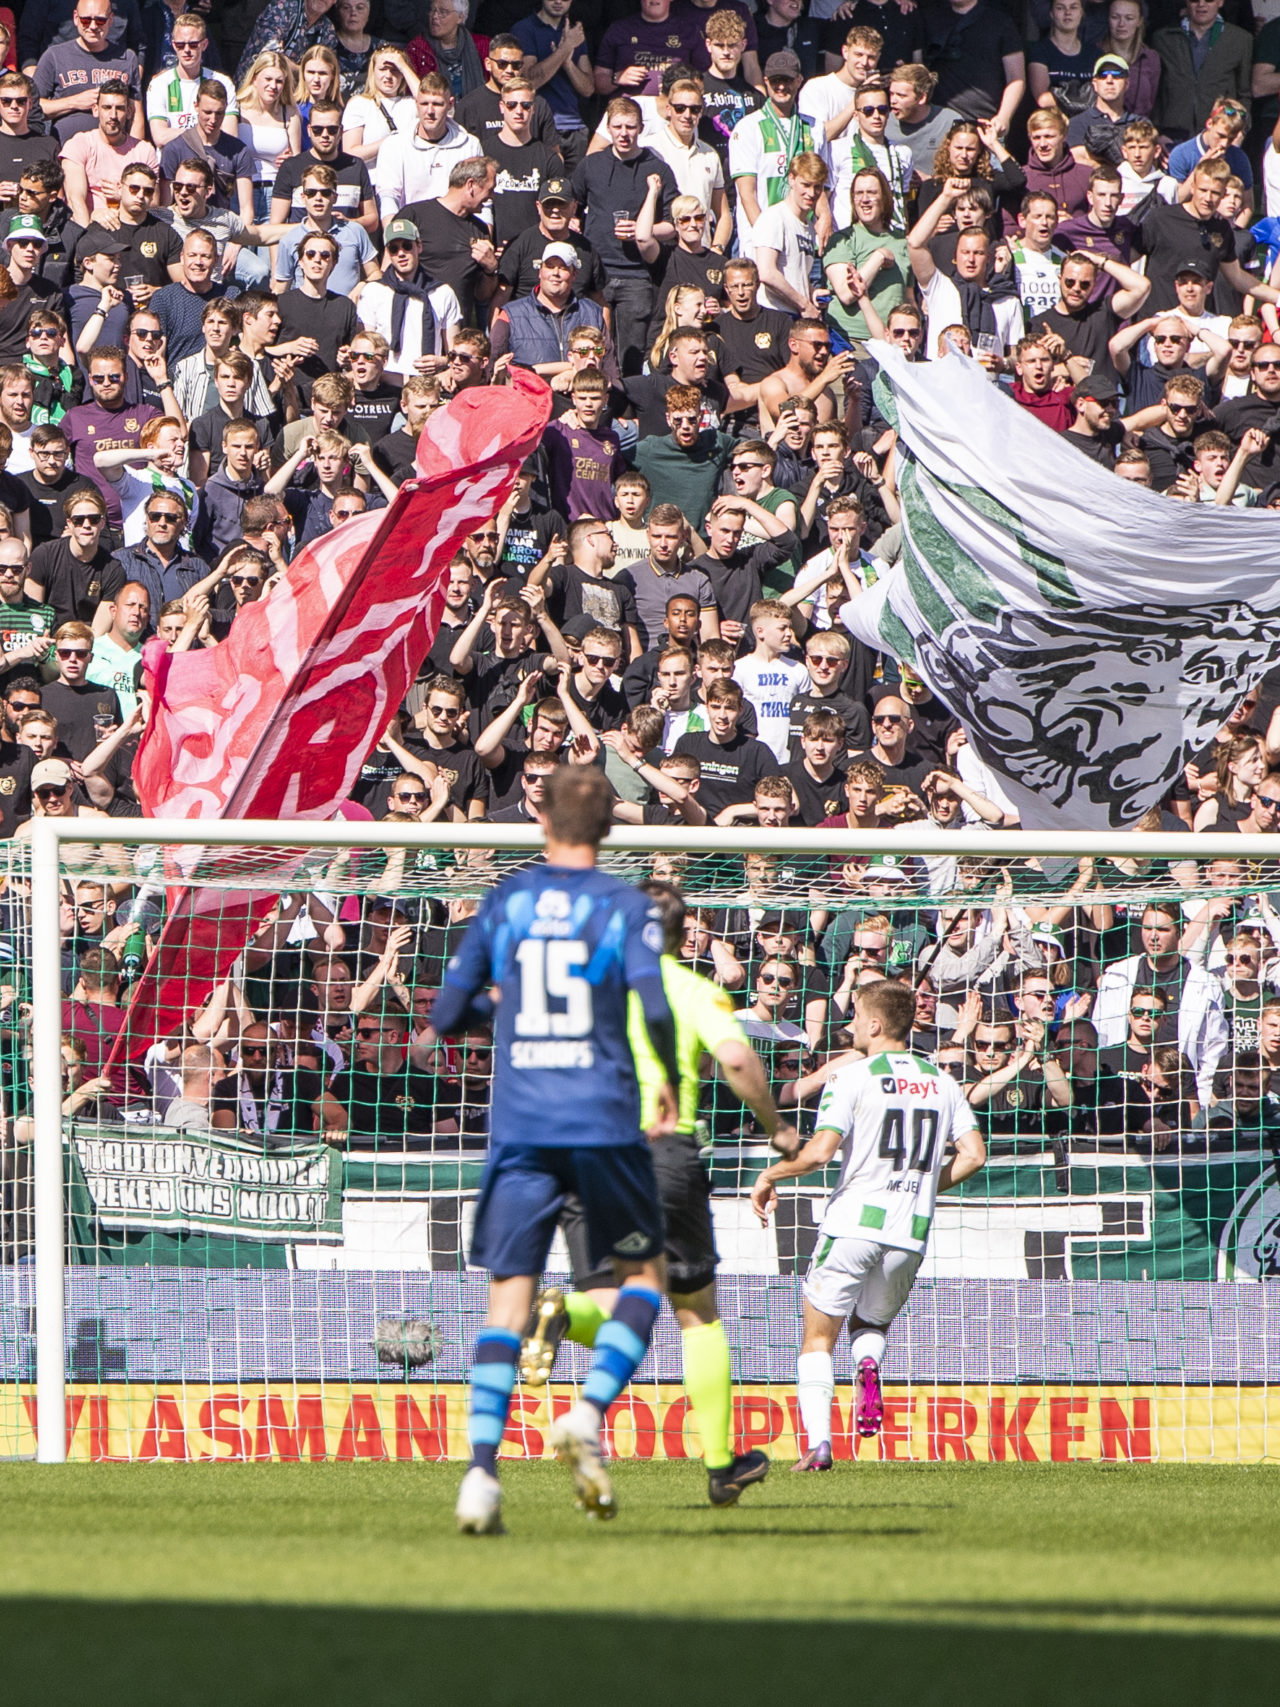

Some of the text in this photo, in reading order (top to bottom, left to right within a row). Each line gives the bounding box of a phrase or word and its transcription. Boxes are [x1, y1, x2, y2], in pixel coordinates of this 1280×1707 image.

[59, 72, 88, 88] LES
[94, 438, 136, 451] OFFICE
[506, 528, 538, 541] AMEN
[514, 939, 592, 1037] 15
[897, 1078, 939, 1099] Payt
[879, 1108, 939, 1172] 40
[237, 1189, 328, 1223] NOOIT
[24, 1394, 1152, 1462] VLASMAN SOOPWERKEN
